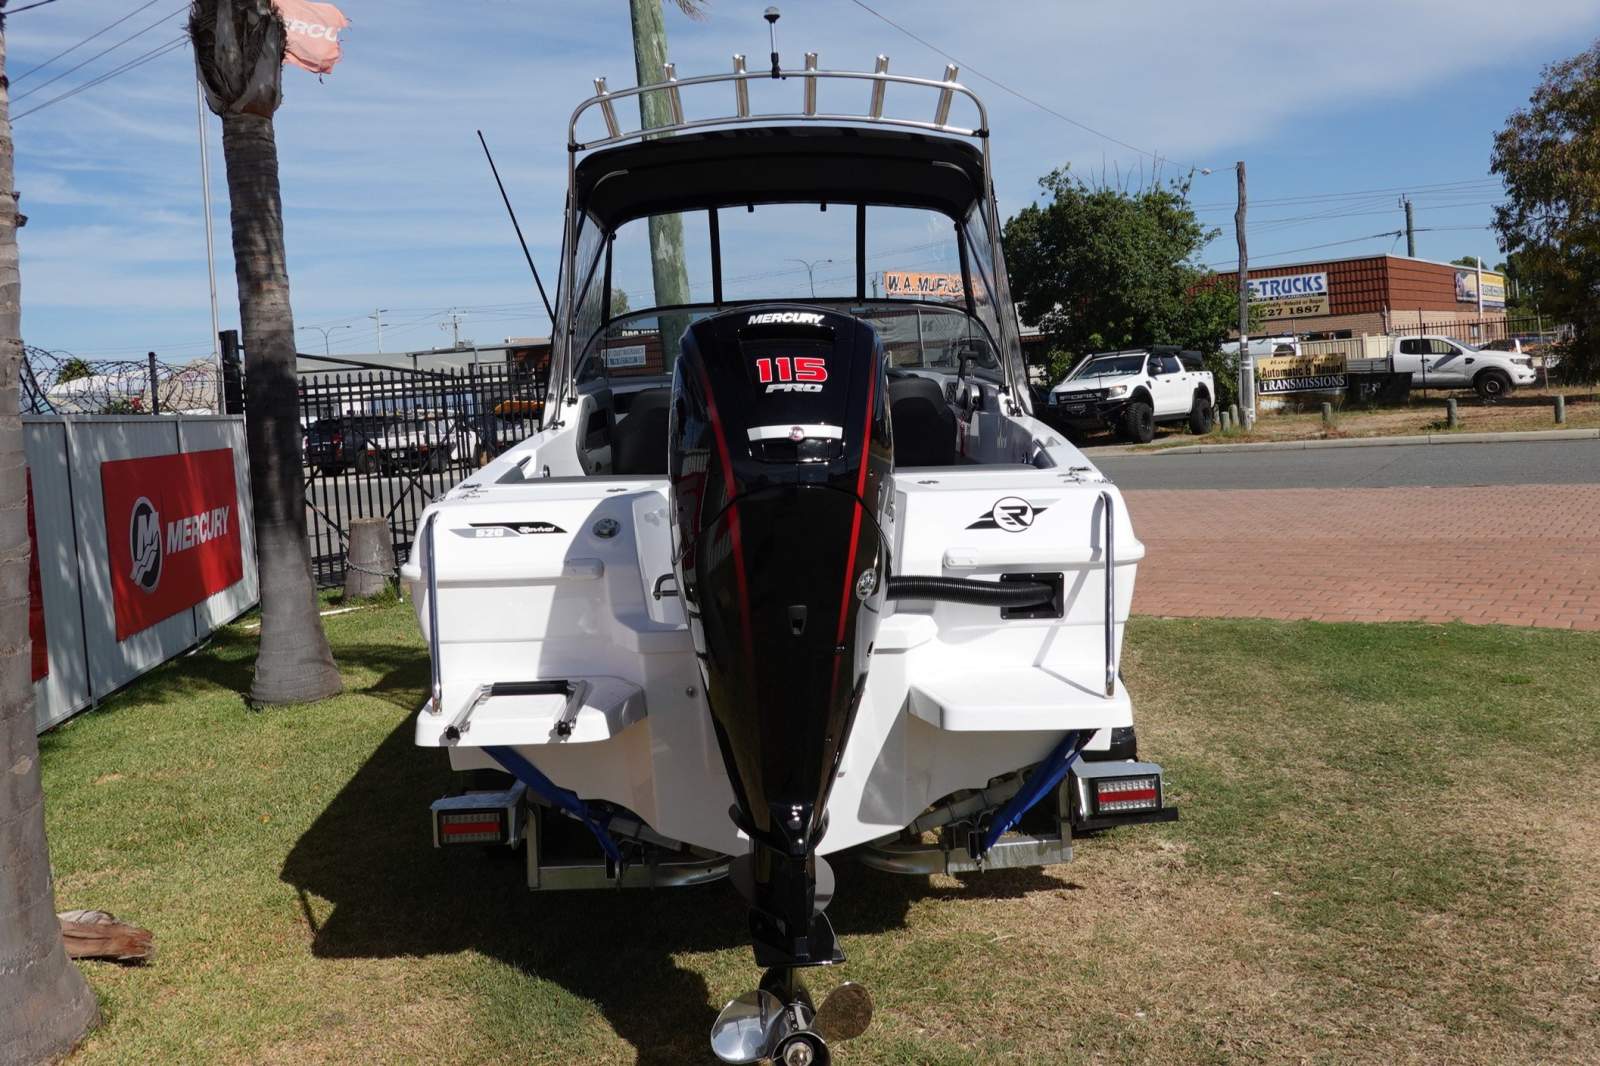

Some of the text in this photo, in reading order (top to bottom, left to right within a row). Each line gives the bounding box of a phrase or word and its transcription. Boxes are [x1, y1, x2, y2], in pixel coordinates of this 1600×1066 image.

[1289, 305, 1320, 315] 1887
[747, 312, 825, 326] MERCURY
[756, 356, 828, 383] 115
[1262, 367, 1302, 378] Automatic
[1314, 363, 1343, 375] Manual
[765, 383, 823, 393] PRO
[1262, 375, 1344, 391] TRANSMISSIONS
[166, 505, 229, 556] MERCURY
